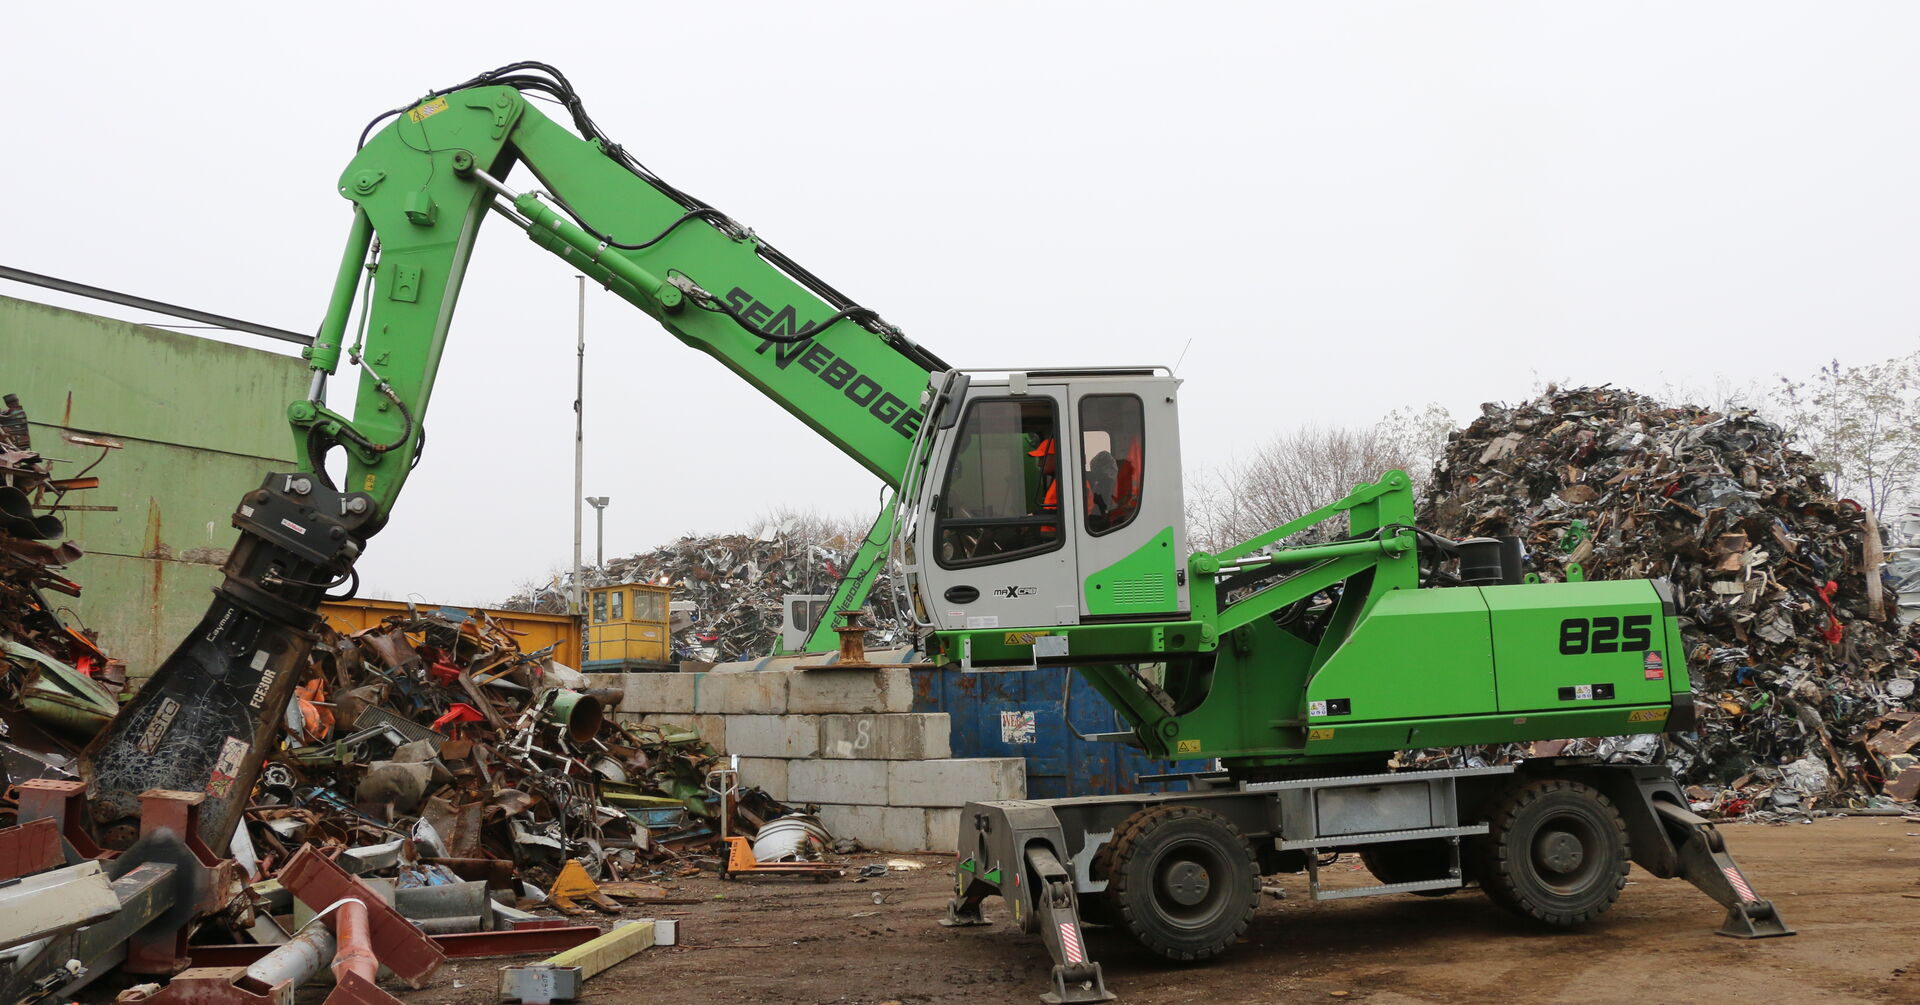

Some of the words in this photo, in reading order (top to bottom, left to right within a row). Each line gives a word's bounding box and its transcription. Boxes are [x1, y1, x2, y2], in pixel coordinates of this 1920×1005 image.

[725, 286, 928, 444] SENNEBOGE
[206, 607, 235, 642] Cayman
[1559, 615, 1652, 655] 825
[249, 668, 277, 710] FCE30R
